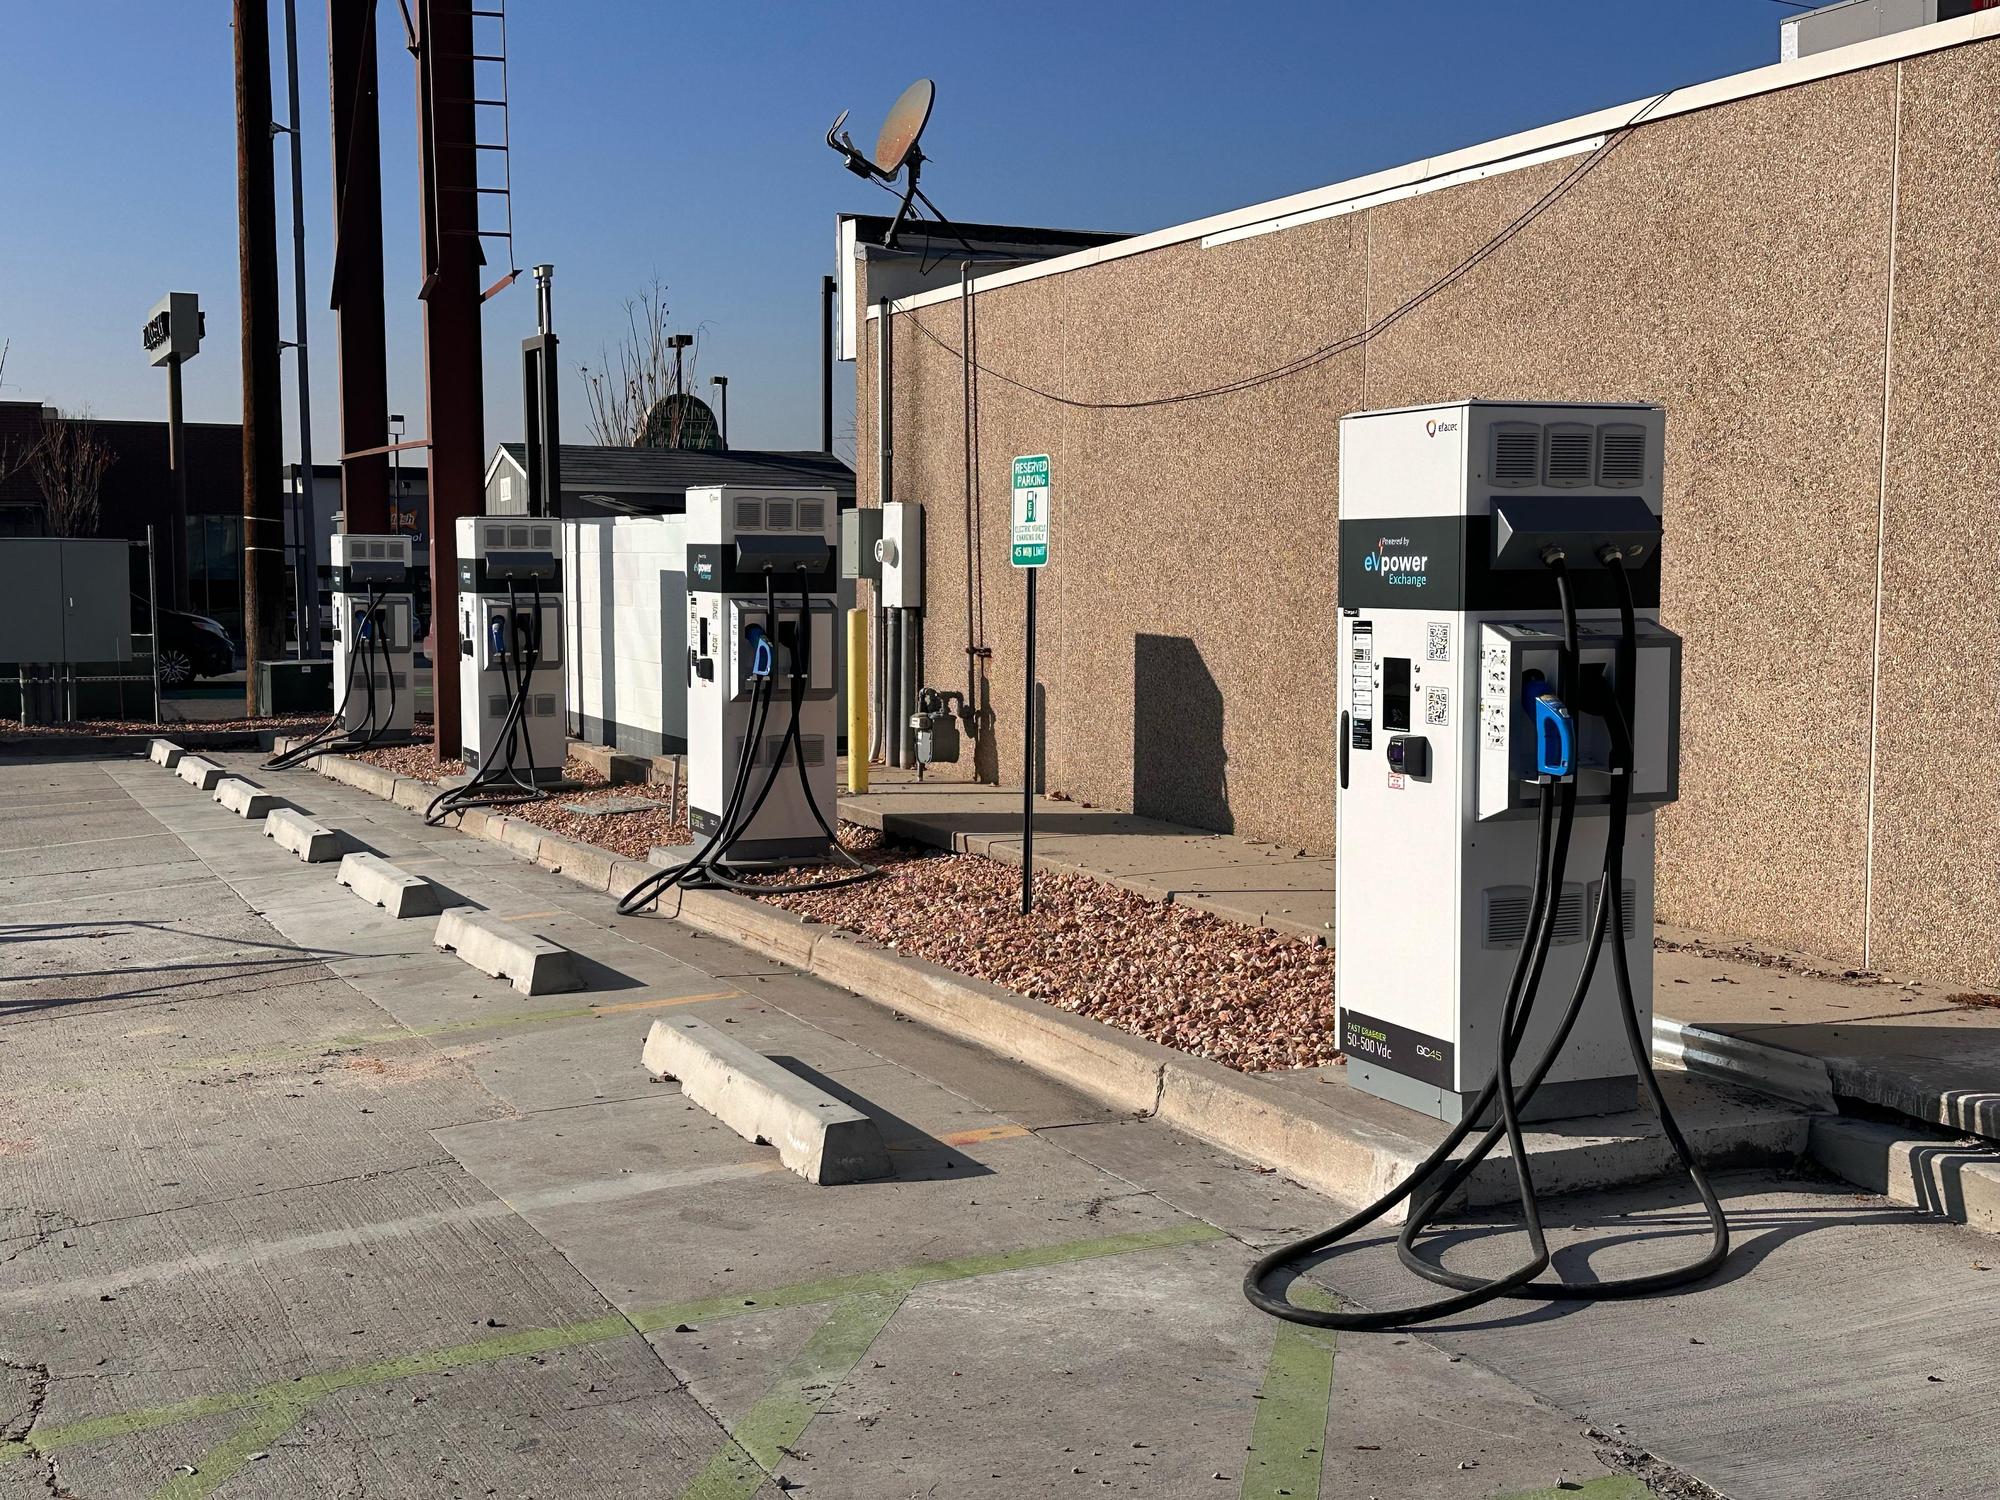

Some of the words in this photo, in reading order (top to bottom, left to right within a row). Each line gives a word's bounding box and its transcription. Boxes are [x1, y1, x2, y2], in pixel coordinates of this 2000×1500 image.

[1015, 461, 1047, 474] RESERVED
[1017, 474, 1046, 487] PARKING
[1389, 573, 1427, 588] Exchange
[1347, 1022, 1361, 1034] FAST
[1361, 1027, 1387, 1042] CHARGER
[1347, 1032, 1375, 1053] 50-500
[1376, 1041, 1392, 1060] Vdc
